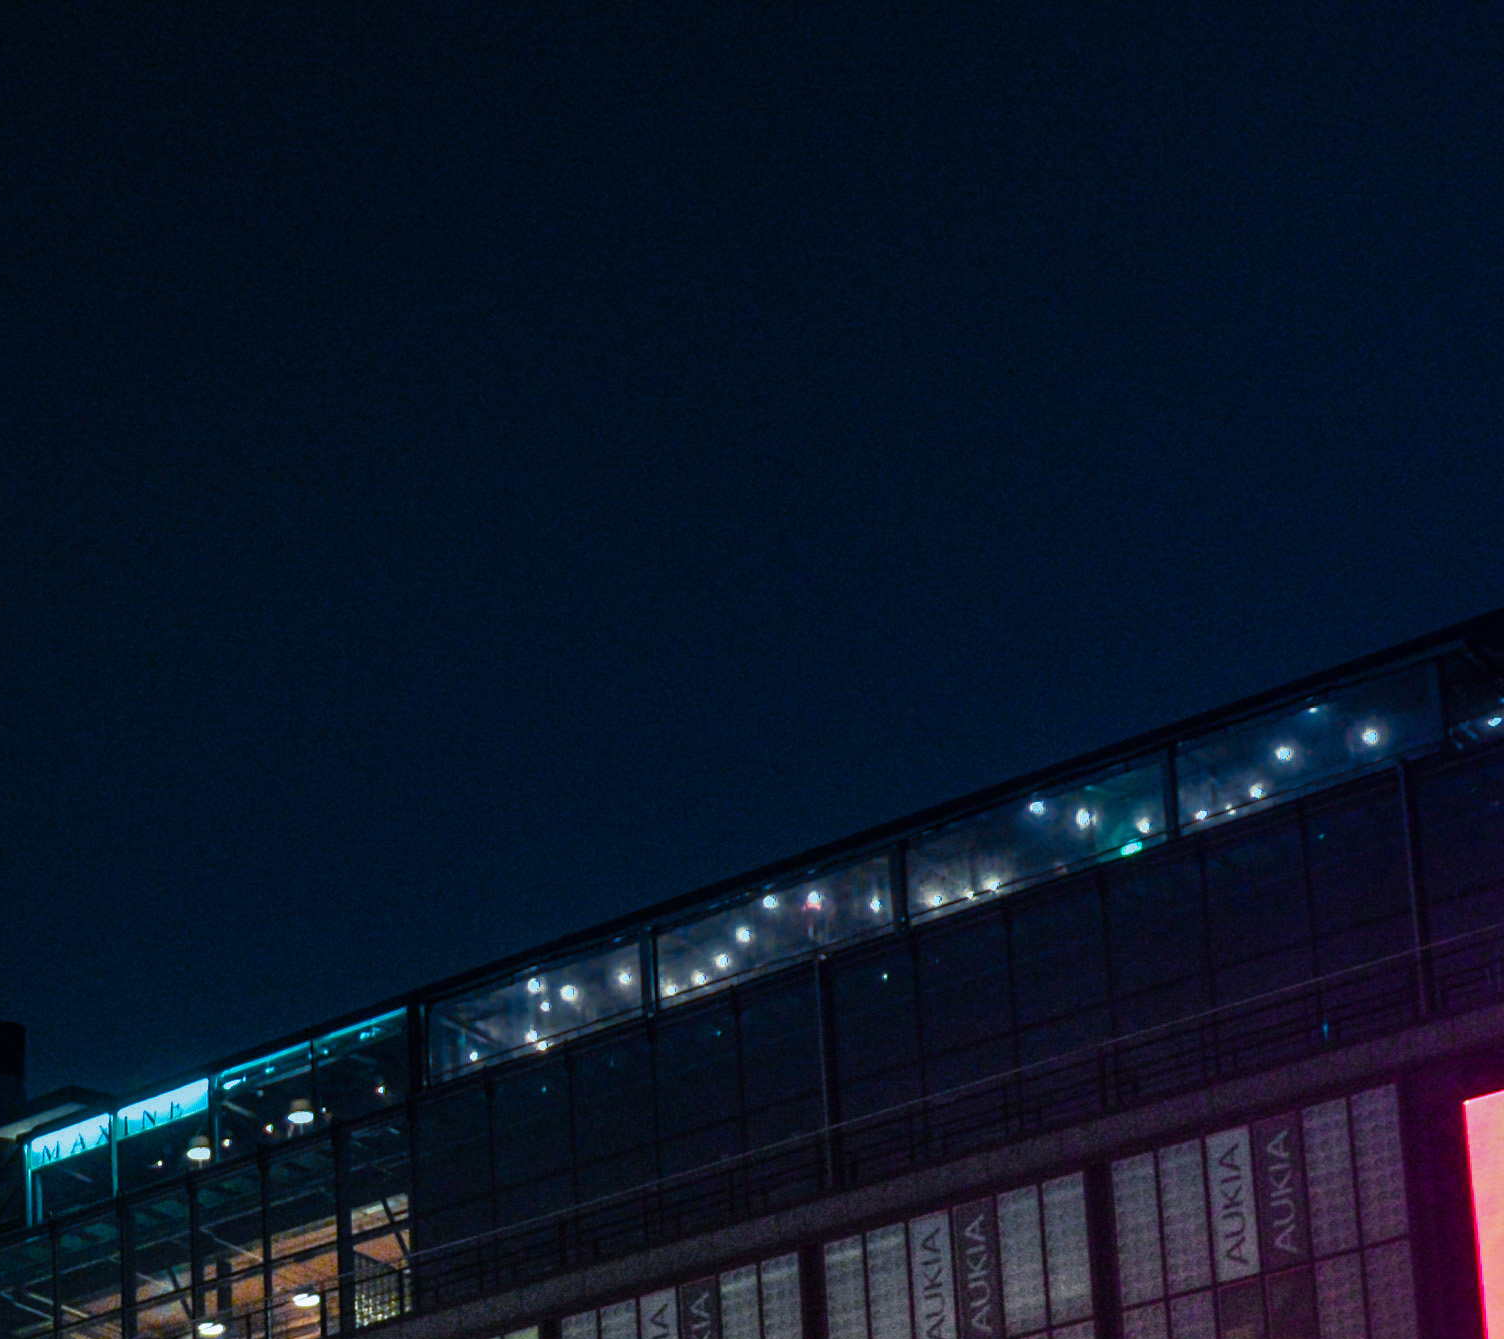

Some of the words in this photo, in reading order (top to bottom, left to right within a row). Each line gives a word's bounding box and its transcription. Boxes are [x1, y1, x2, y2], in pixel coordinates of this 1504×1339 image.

[38, 1099, 189, 1166] MAXINE
[1271, 1127, 1303, 1258] AUKIA
[1224, 1139, 1249, 1268] AUKIA
[967, 1212, 997, 1336] AUKIA
